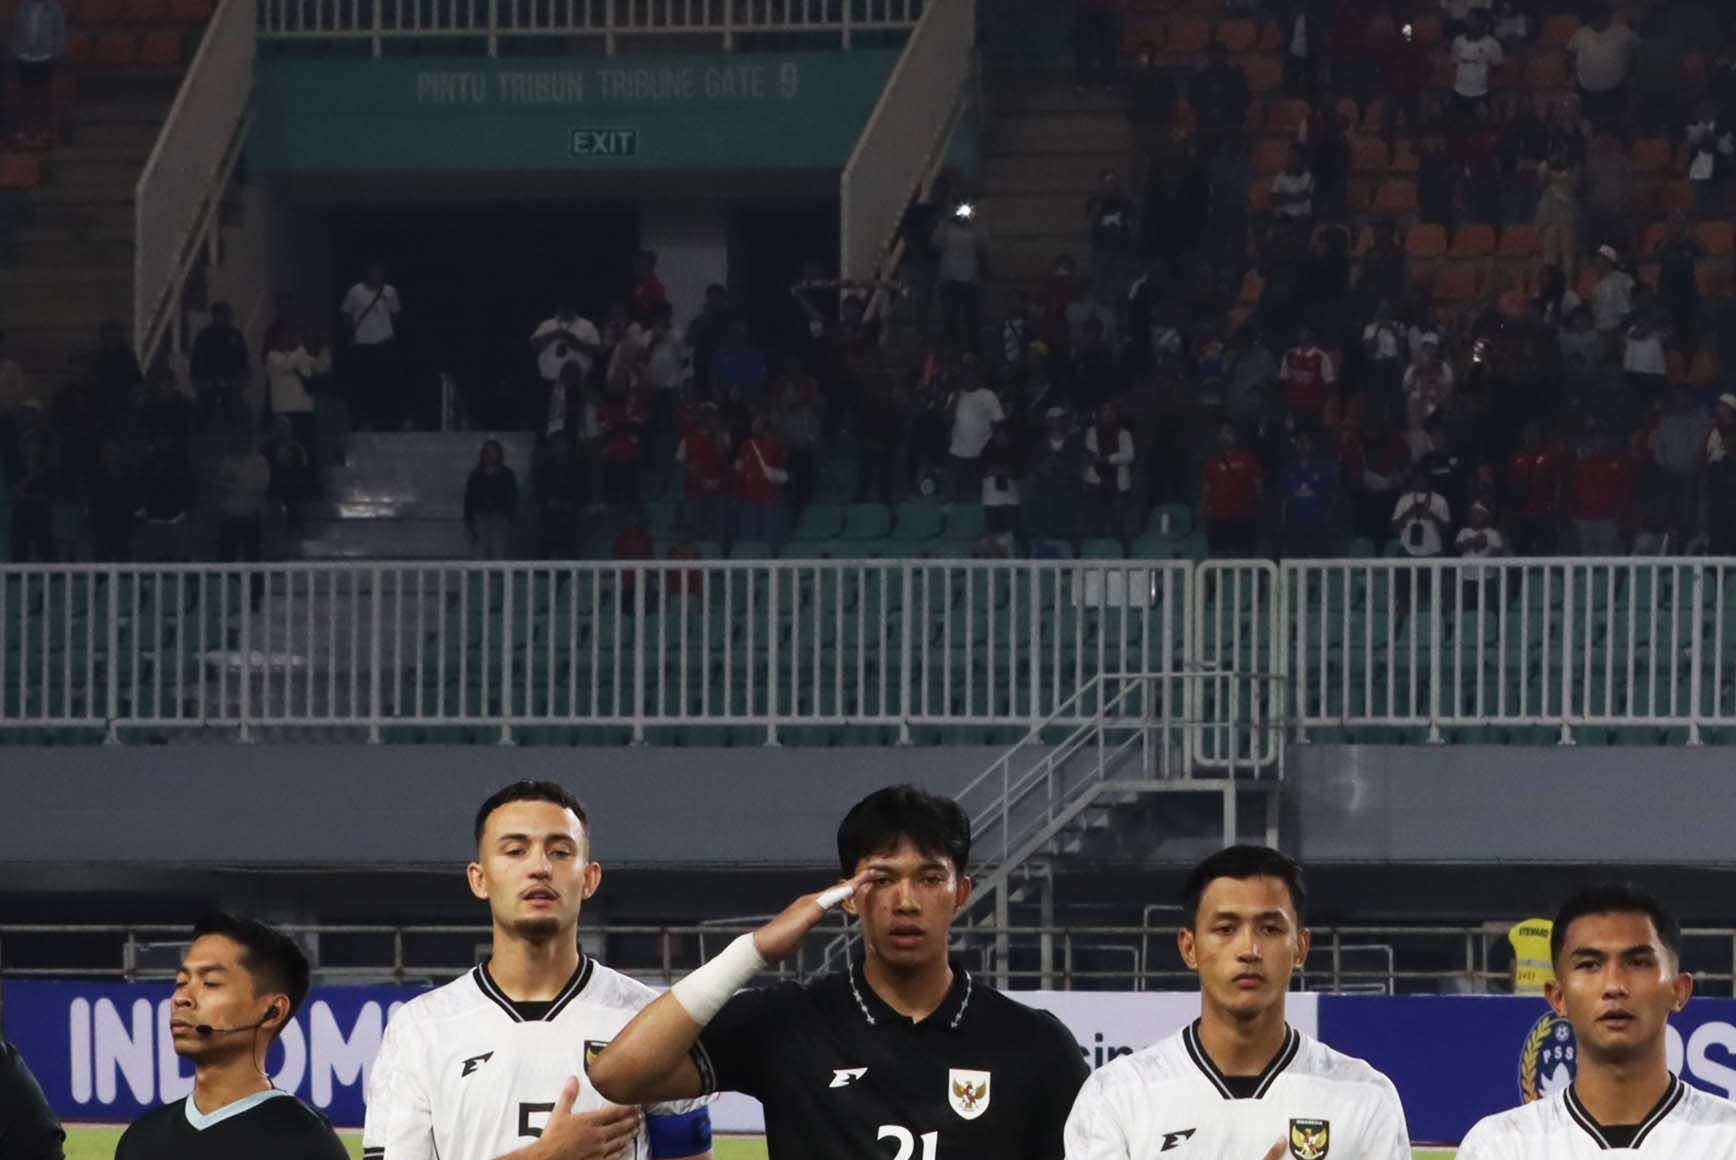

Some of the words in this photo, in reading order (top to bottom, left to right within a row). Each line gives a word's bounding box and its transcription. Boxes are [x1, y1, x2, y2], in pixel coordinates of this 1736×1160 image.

[416, 72, 487, 103] PINTU
[499, 71, 584, 102] TRIBUN
[598, 68, 696, 99] TRIBUNE
[704, 65, 765, 97] GATE
[779, 61, 800, 98] 9
[573, 132, 634, 154] EXIT
